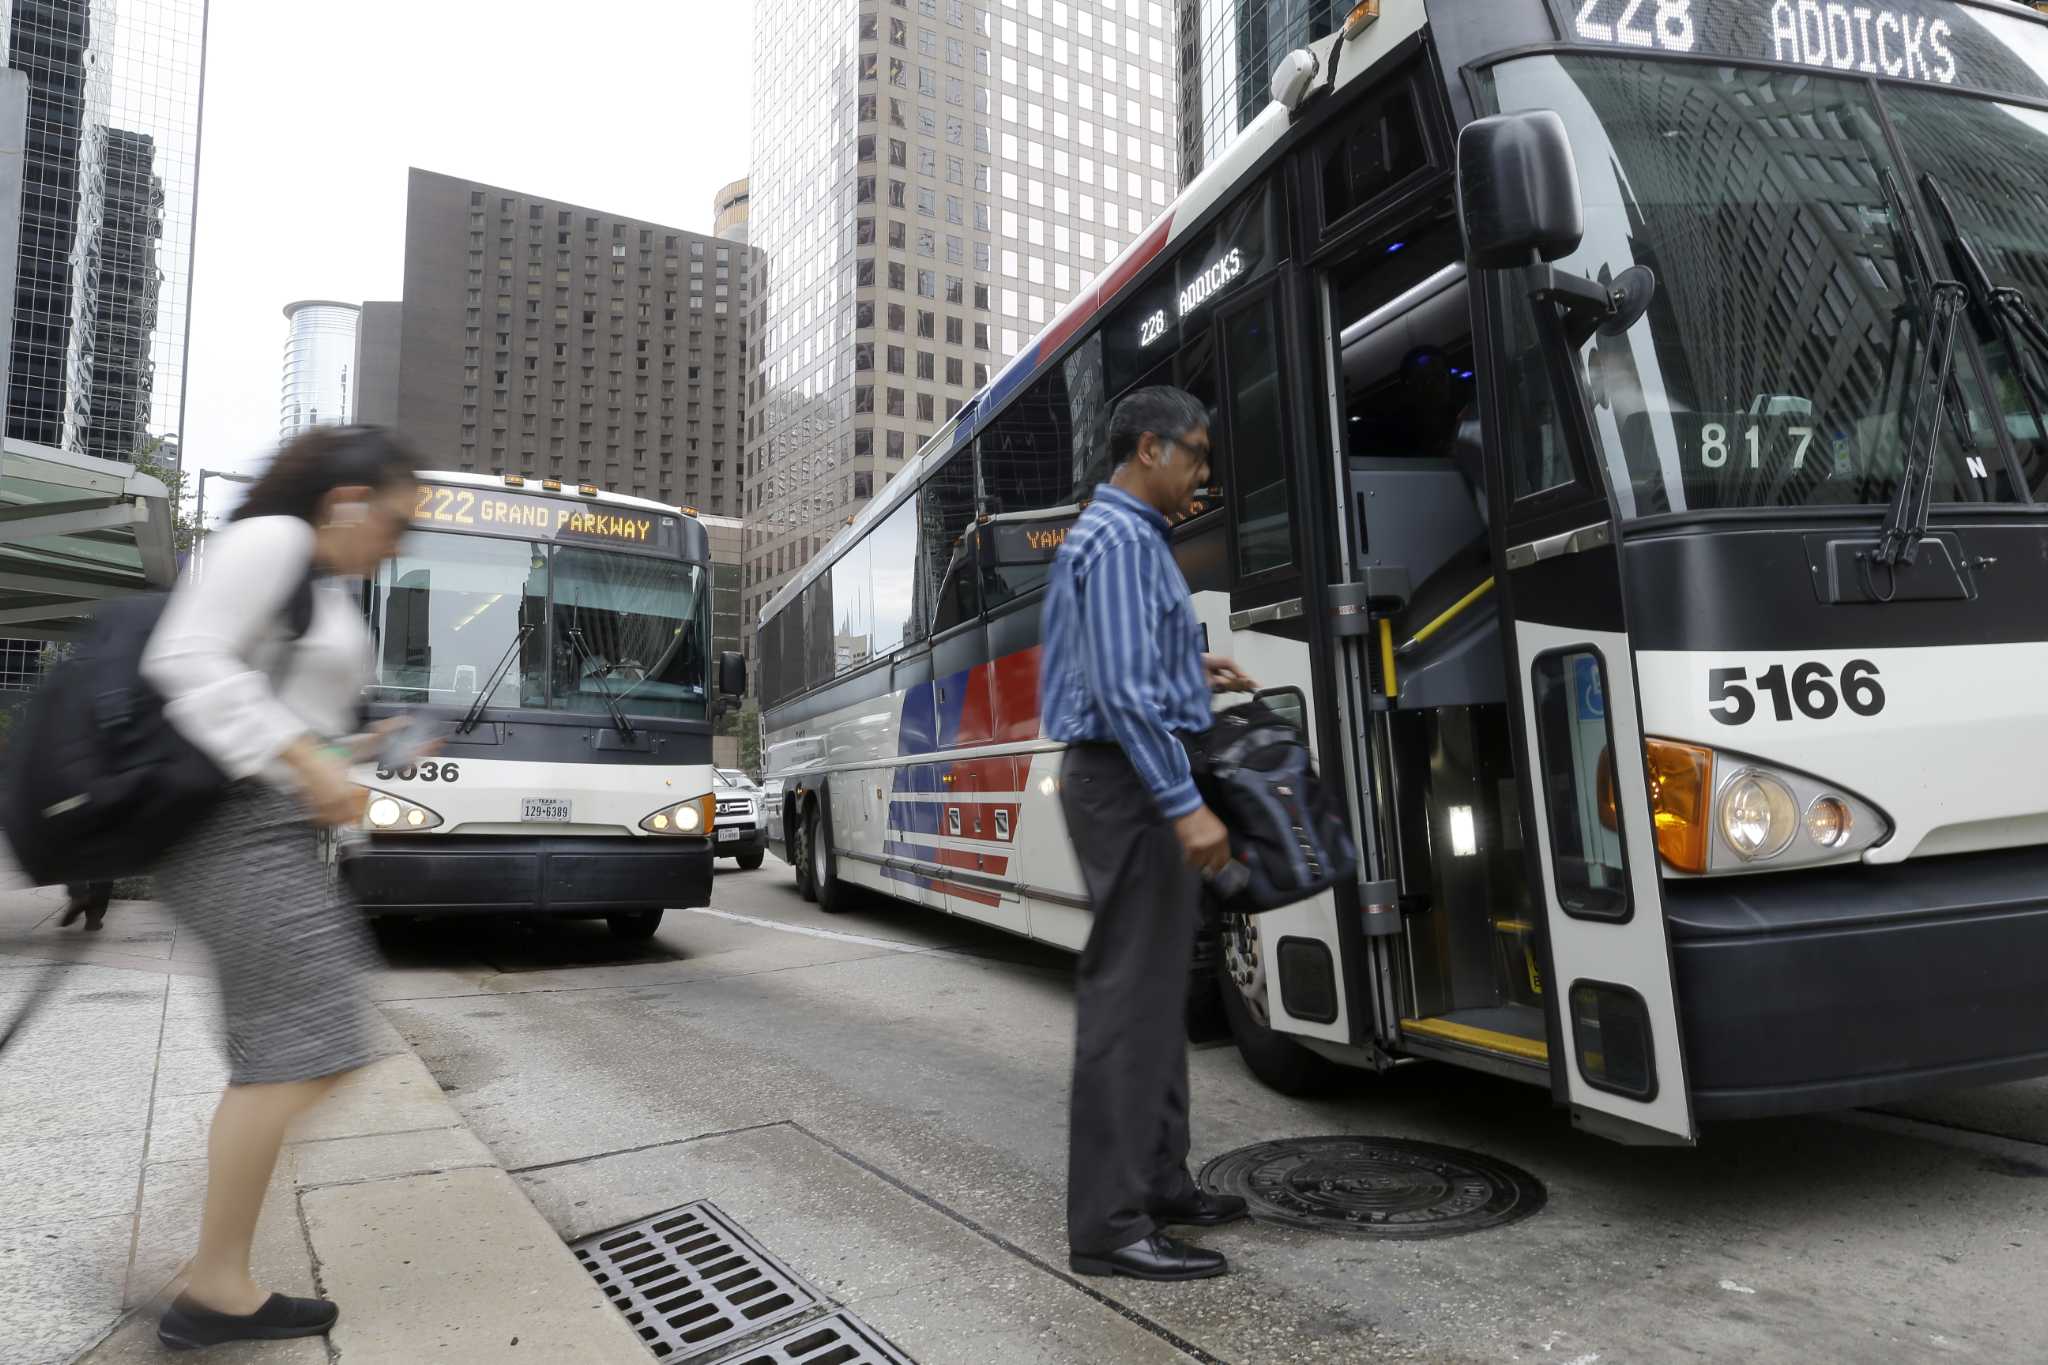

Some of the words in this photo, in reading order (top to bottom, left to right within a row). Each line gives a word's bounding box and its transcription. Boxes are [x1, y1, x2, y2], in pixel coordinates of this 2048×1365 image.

[1771, 0, 1956, 83] ADDICKS
[1140, 309, 1164, 346] 228
[1179, 248, 1240, 317] ADDICKS
[414, 486, 475, 523] 222
[481, 500, 549, 527] GRAND
[557, 509, 650, 541] PARKWAY
[1709, 658, 1886, 726] 5166
